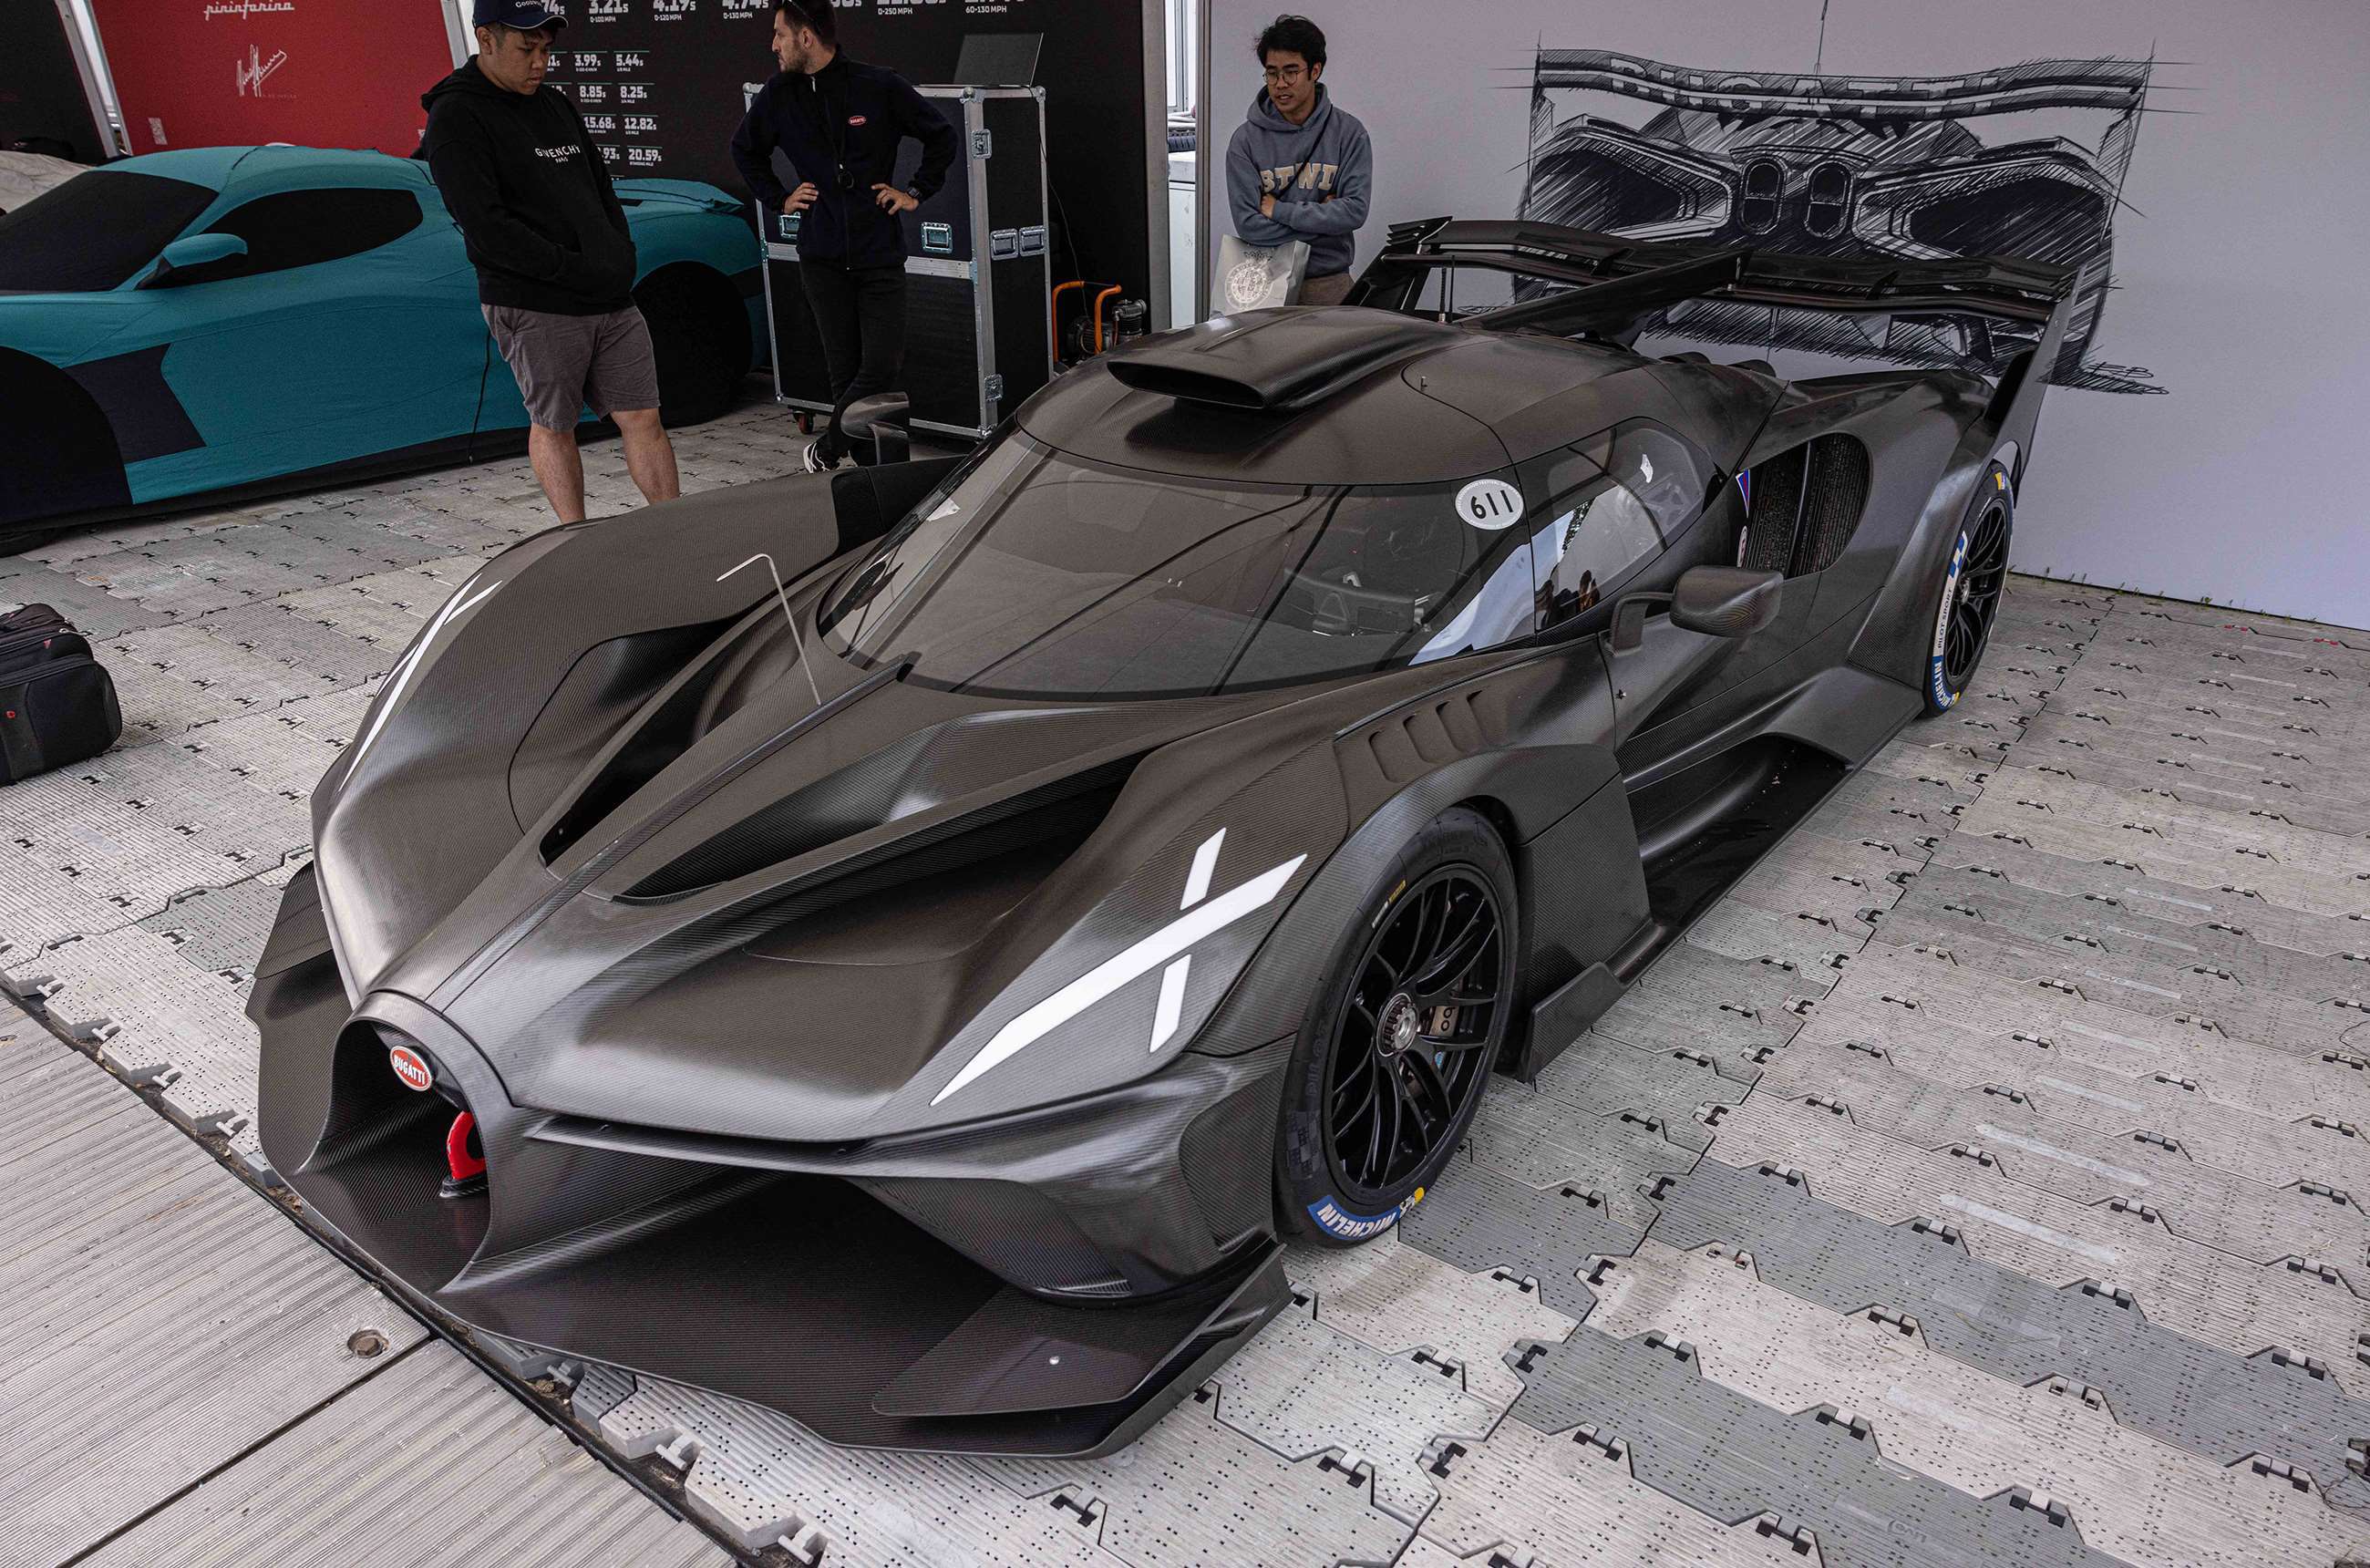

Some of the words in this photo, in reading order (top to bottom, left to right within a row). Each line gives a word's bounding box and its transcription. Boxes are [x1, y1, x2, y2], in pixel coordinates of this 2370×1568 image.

[203, 0, 295, 21] pininfarina
[589, 0, 629, 15] 3.21s
[878, 7, 897, 15] 0-250
[990, 5, 1007, 14] MPH
[574, 54, 602, 67] 3.99s
[615, 54, 644, 67] 5.44s
[580, 86, 606, 98] 8.85s
[620, 86, 647, 98] 8.25s
[583, 117, 615, 129] 15.68s
[624, 118, 656, 130] 12.82s
[628, 149, 662, 162] 20.59s
[1470, 490, 1513, 520] 611
[393, 1054, 426, 1086] BUGATTI
[1316, 1202, 1396, 1238] MICHELIN
